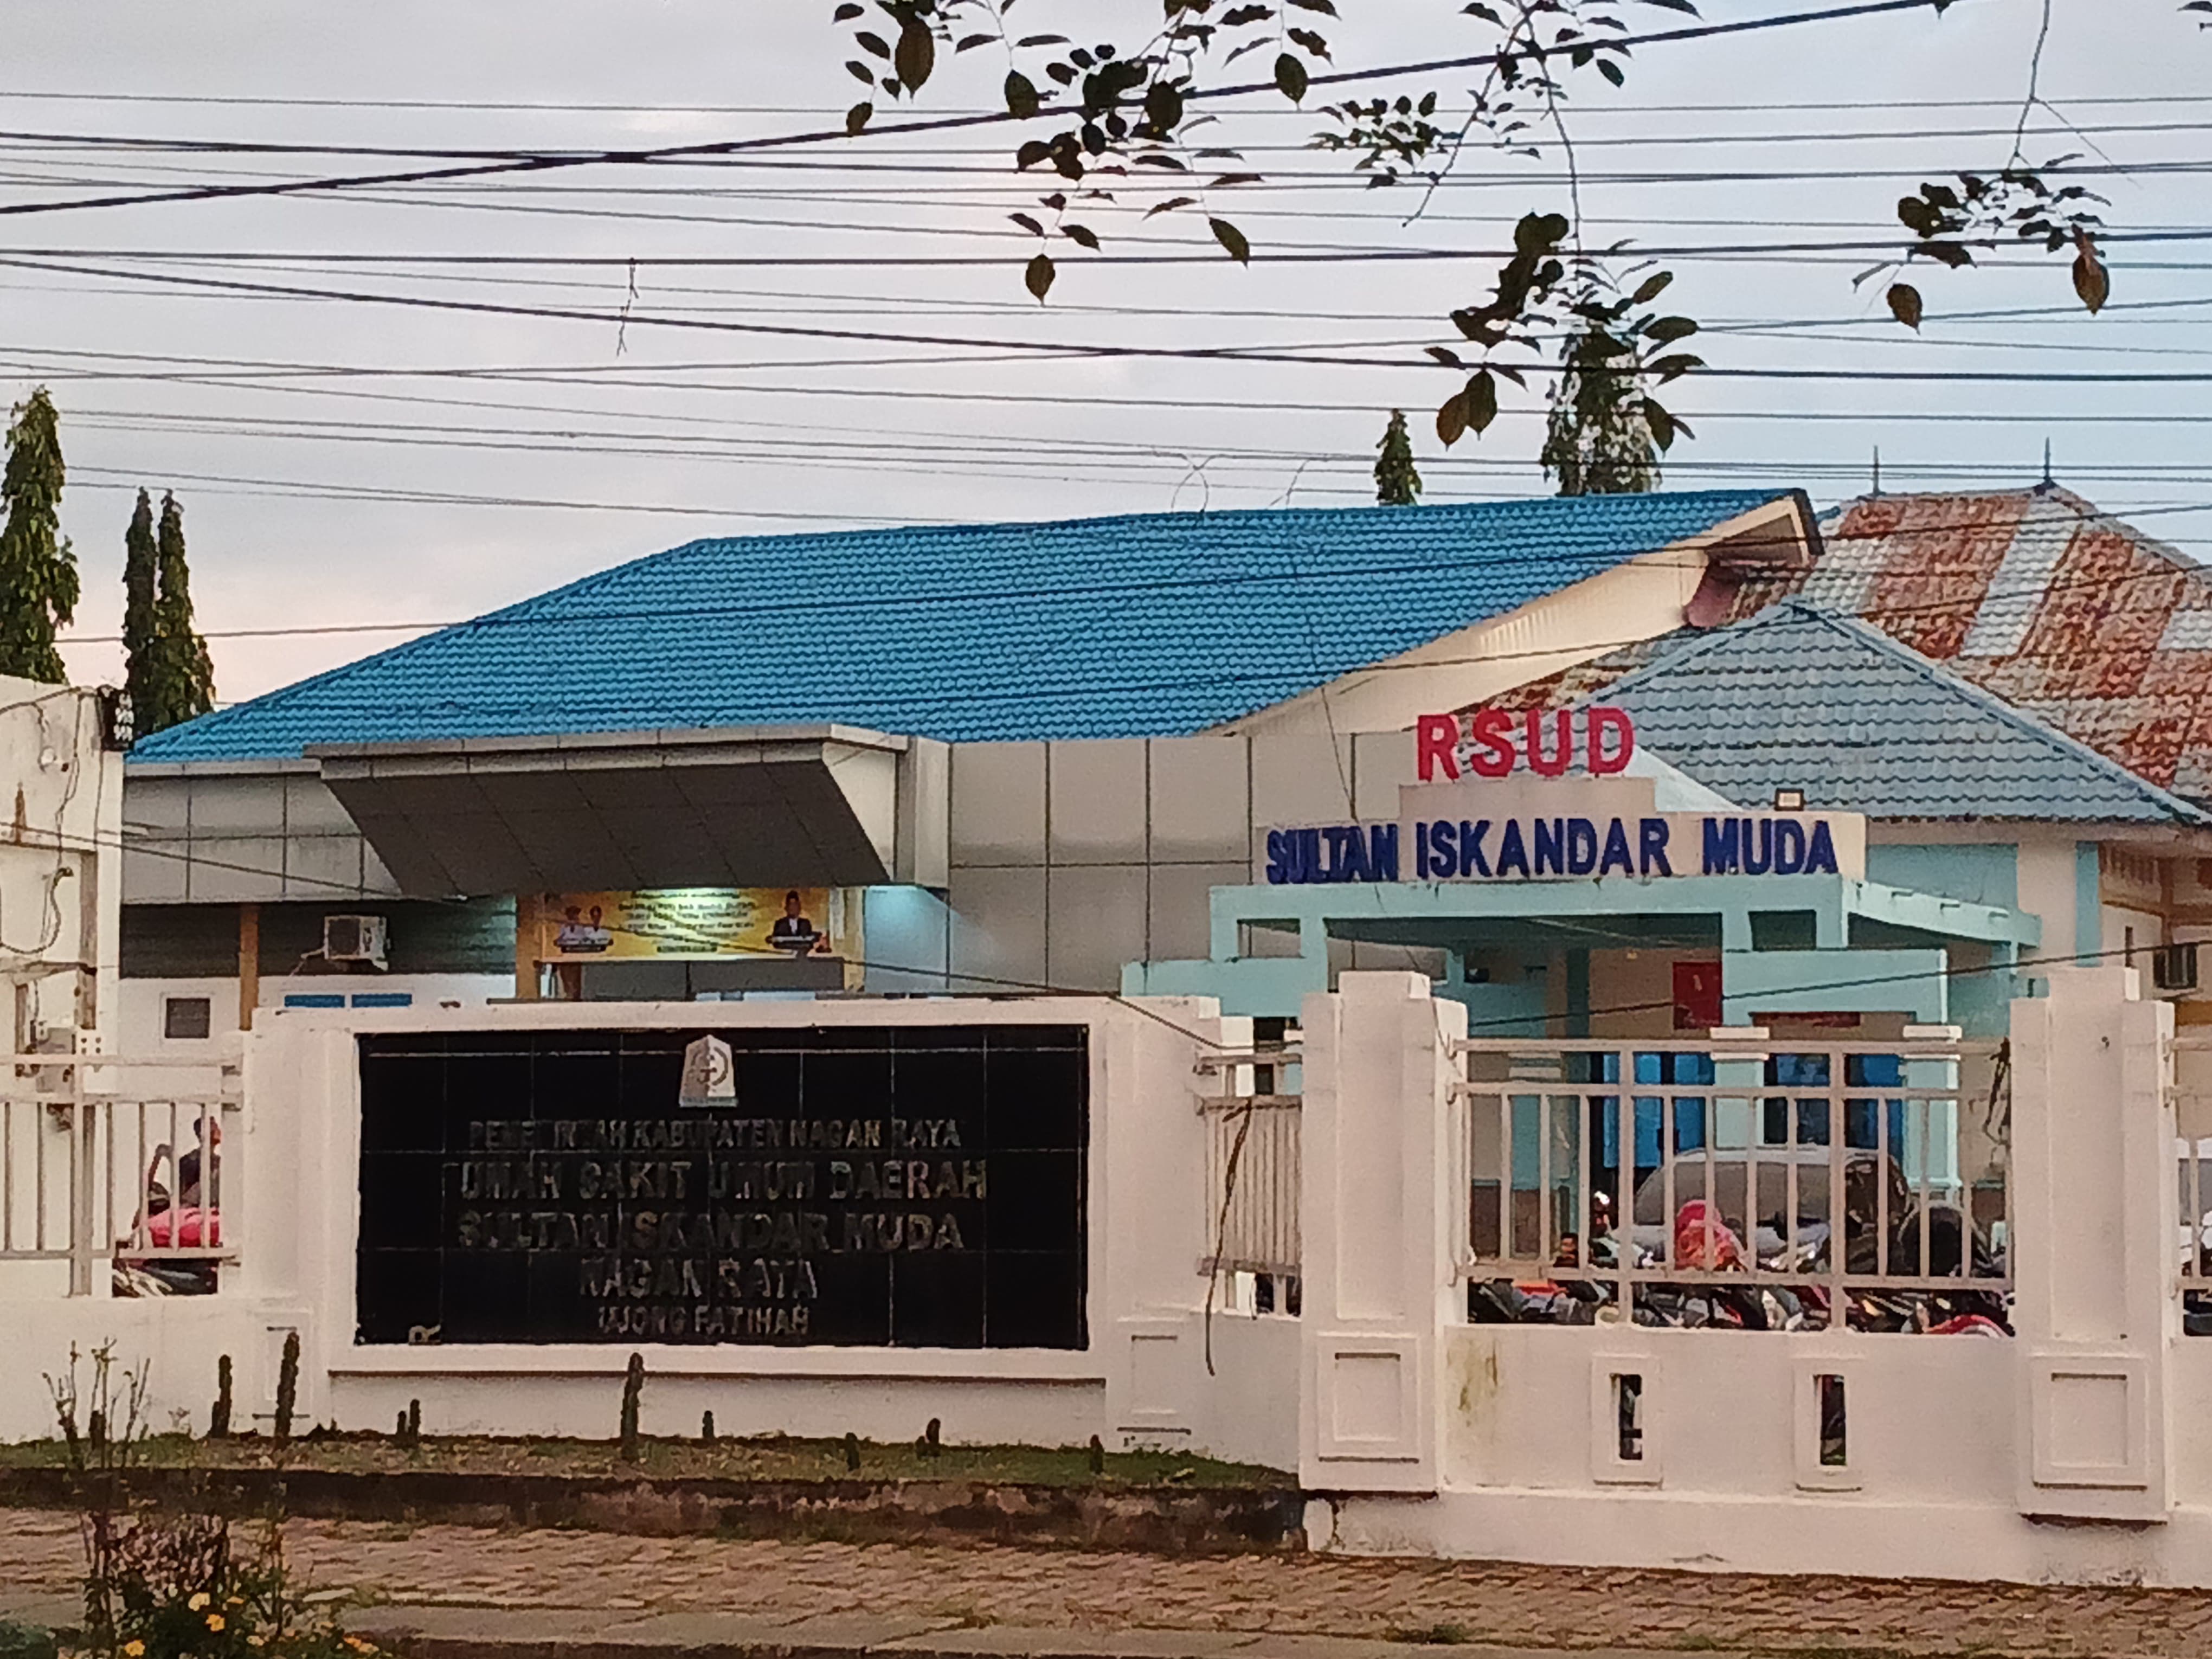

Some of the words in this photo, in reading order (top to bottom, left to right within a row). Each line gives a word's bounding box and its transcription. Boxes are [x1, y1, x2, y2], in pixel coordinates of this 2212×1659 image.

[1417, 705, 1636, 782] RSUD
[1265, 822, 1399, 885] SULTAN
[1416, 816, 1674, 880] ISKANDAR
[1701, 816, 1840, 876] MUDA
[790, 1118, 882, 1148] NAGAN
[891, 1118, 961, 1148] RAYA
[580, 1161, 692, 1200] SAKIT
[829, 1159, 987, 1200] DAERAH
[844, 1212, 964, 1250] MUDA
